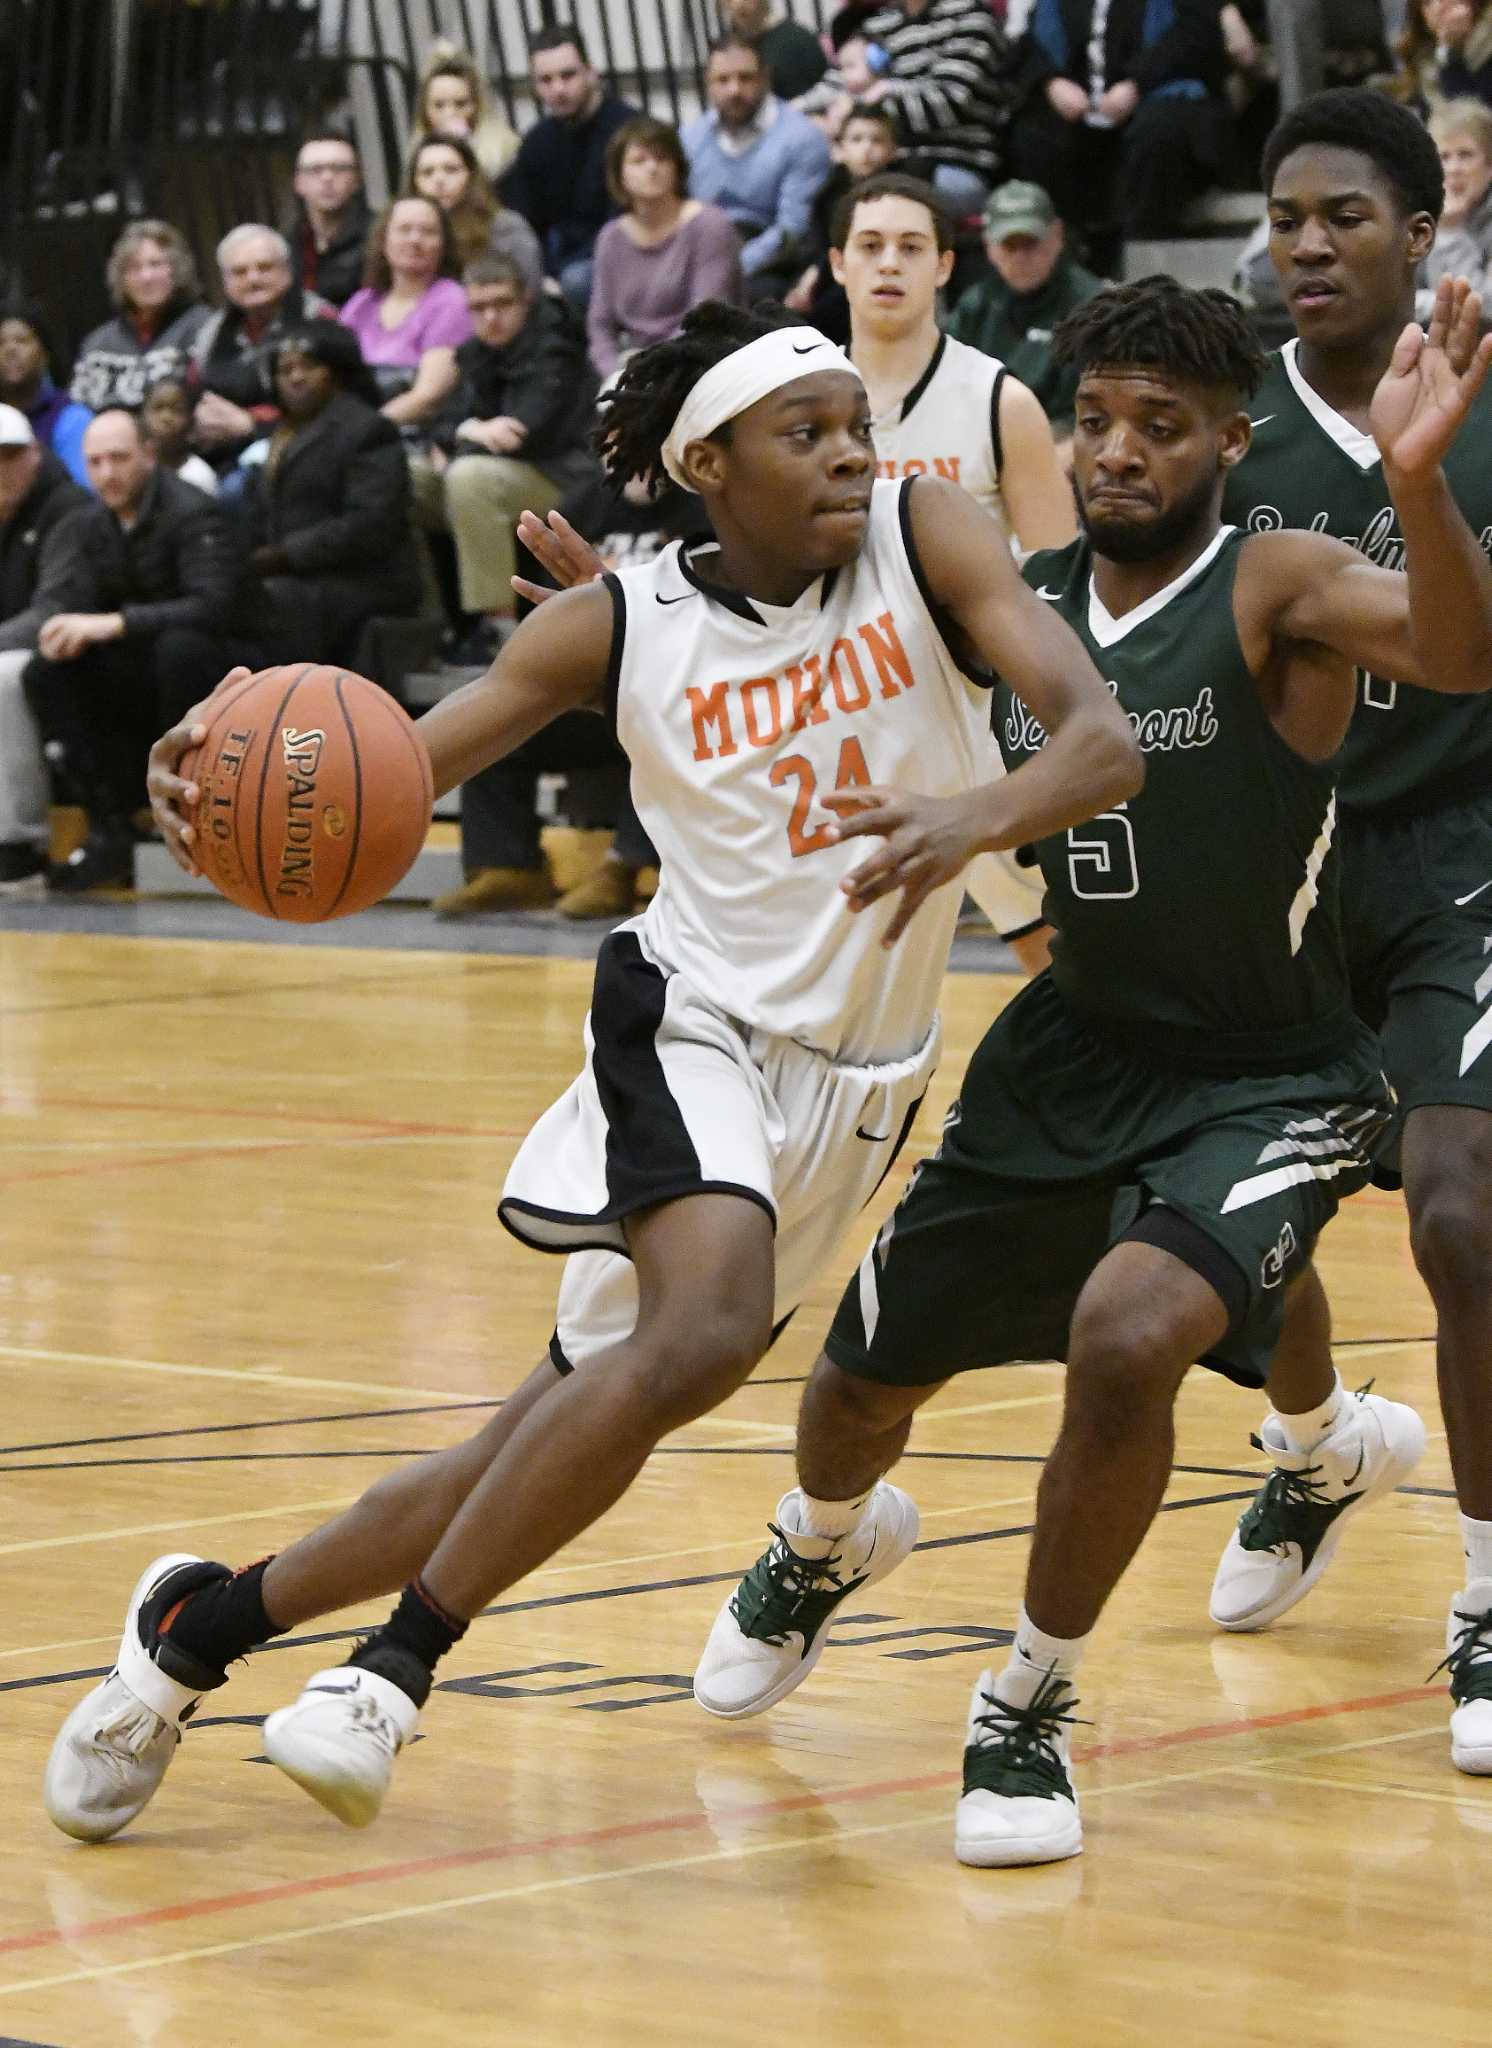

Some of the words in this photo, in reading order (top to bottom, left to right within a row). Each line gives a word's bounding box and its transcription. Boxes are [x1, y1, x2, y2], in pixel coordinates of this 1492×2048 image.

[686, 611, 916, 762] MOHON
[276, 727, 327, 897] SPALDING
[768, 735, 875, 858] 24
[1067, 801, 1140, 900] 5
